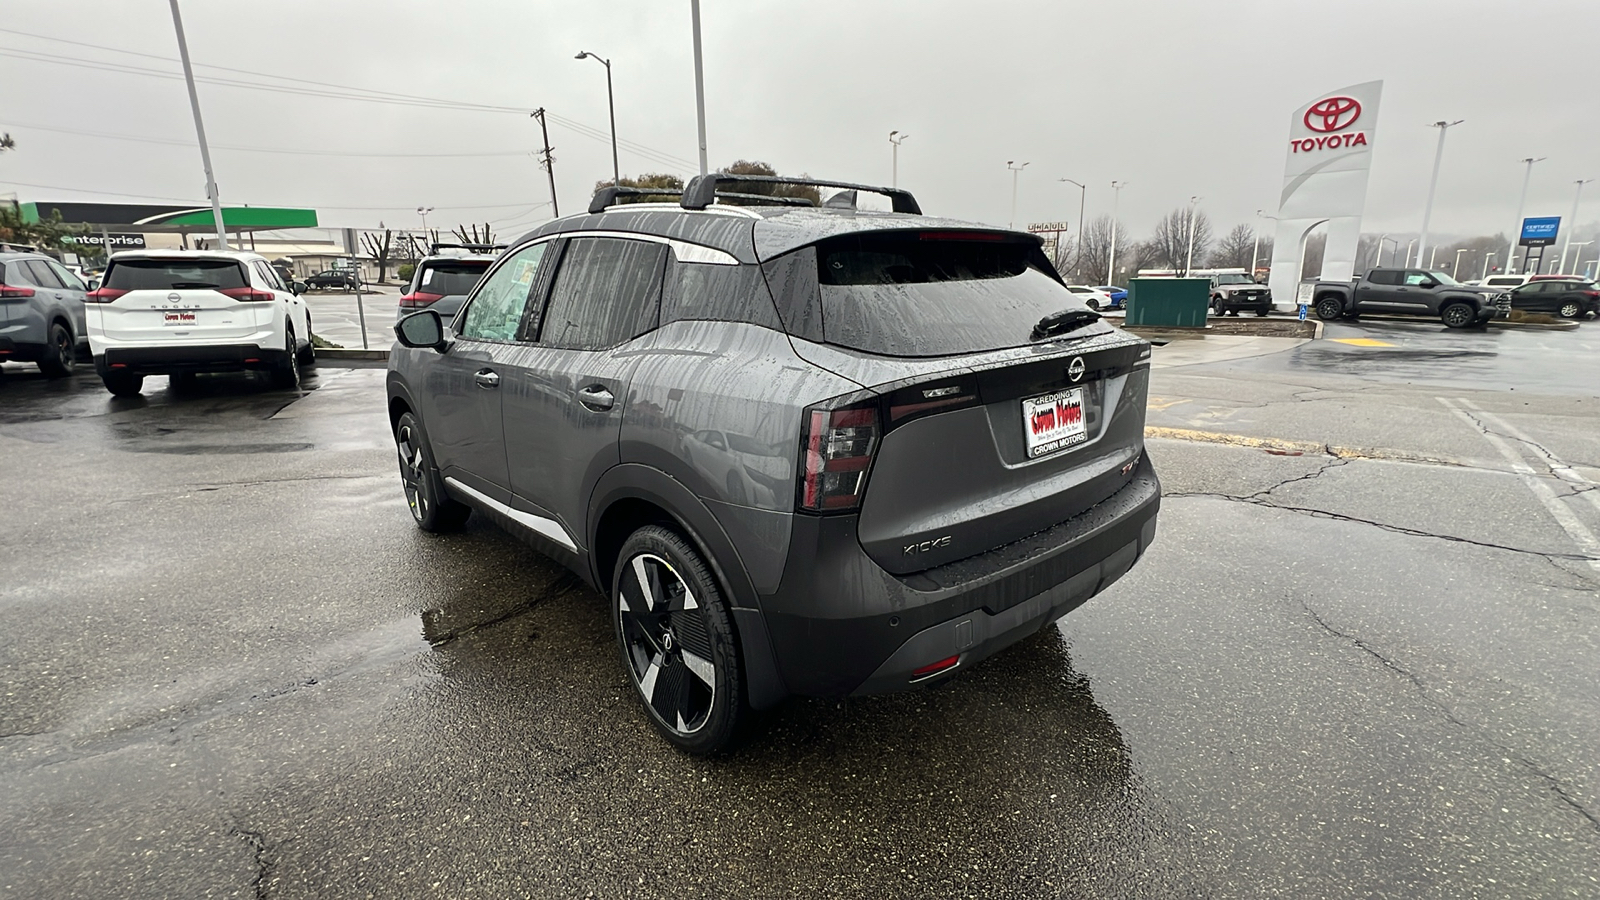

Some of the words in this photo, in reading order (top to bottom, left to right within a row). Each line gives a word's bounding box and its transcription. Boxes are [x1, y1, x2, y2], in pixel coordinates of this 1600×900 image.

[1291, 132, 1367, 153] TOYOTA
[1040, 390, 1071, 404] REDDING
[1029, 406, 1056, 435] Crown
[1056, 399, 1082, 429] Motors
[1034, 440, 1059, 455] CROWN
[1060, 432, 1085, 447] MOTORS
[903, 535, 952, 557] KICKS
